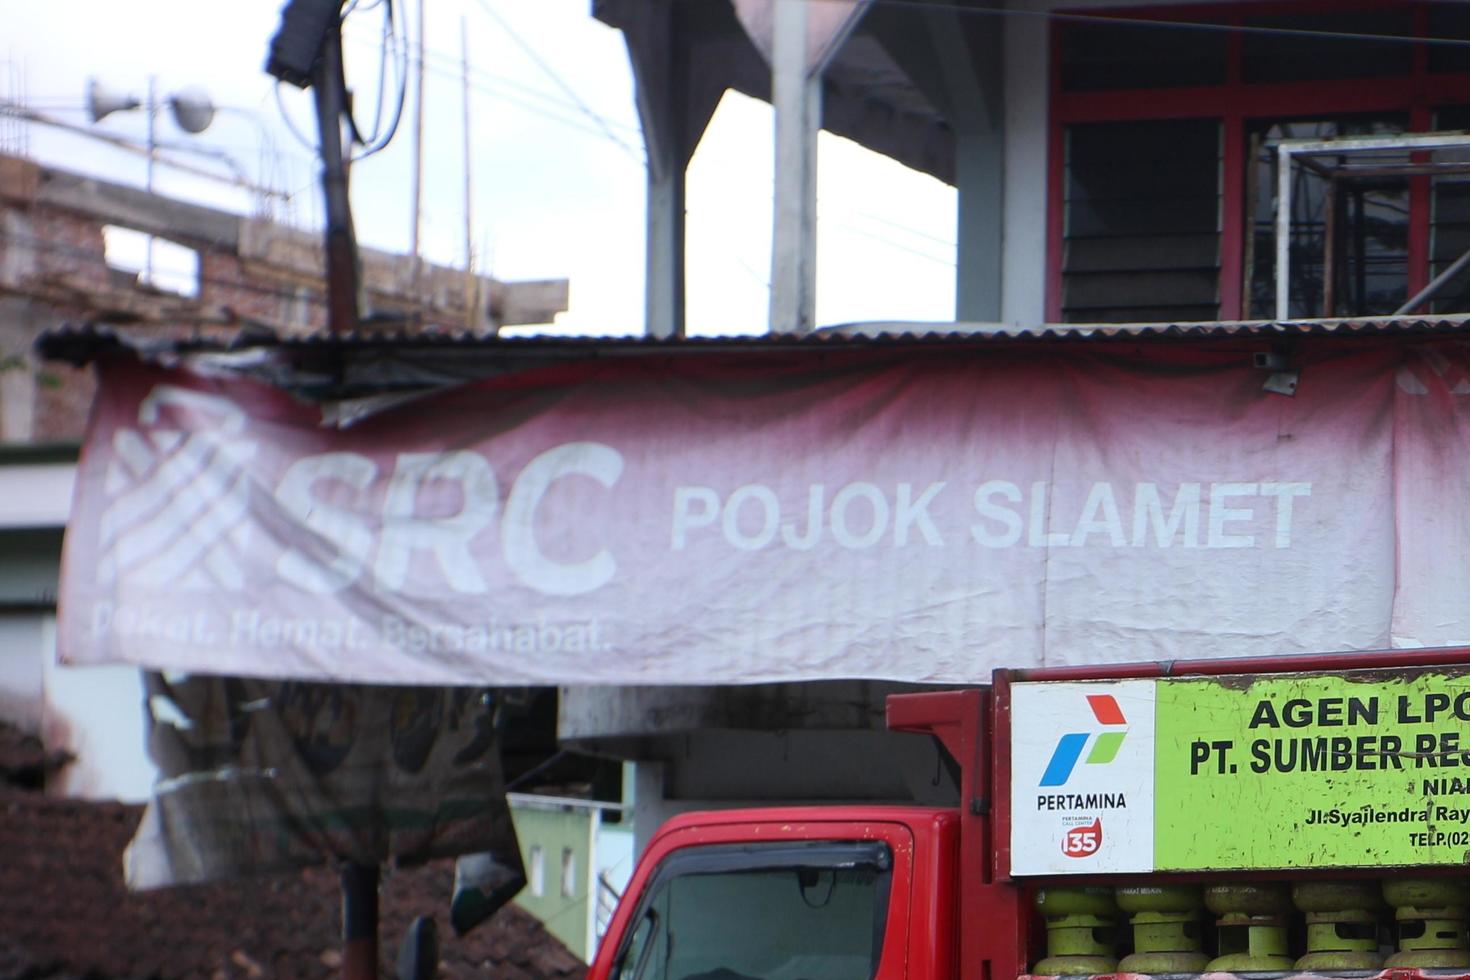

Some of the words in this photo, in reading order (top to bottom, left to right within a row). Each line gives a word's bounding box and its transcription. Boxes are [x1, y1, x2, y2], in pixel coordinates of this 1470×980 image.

[275, 442, 624, 597] SRC
[671, 481, 949, 551] POJOK
[970, 481, 1311, 549] SLAMET
[1248, 696, 1379, 729] AGEN
[1190, 740, 1239, 776] PT.
[1250, 735, 1402, 774] SUMBER
[1037, 793, 1127, 811] PERTAMINA
[1063, 832, 1097, 853] 135
